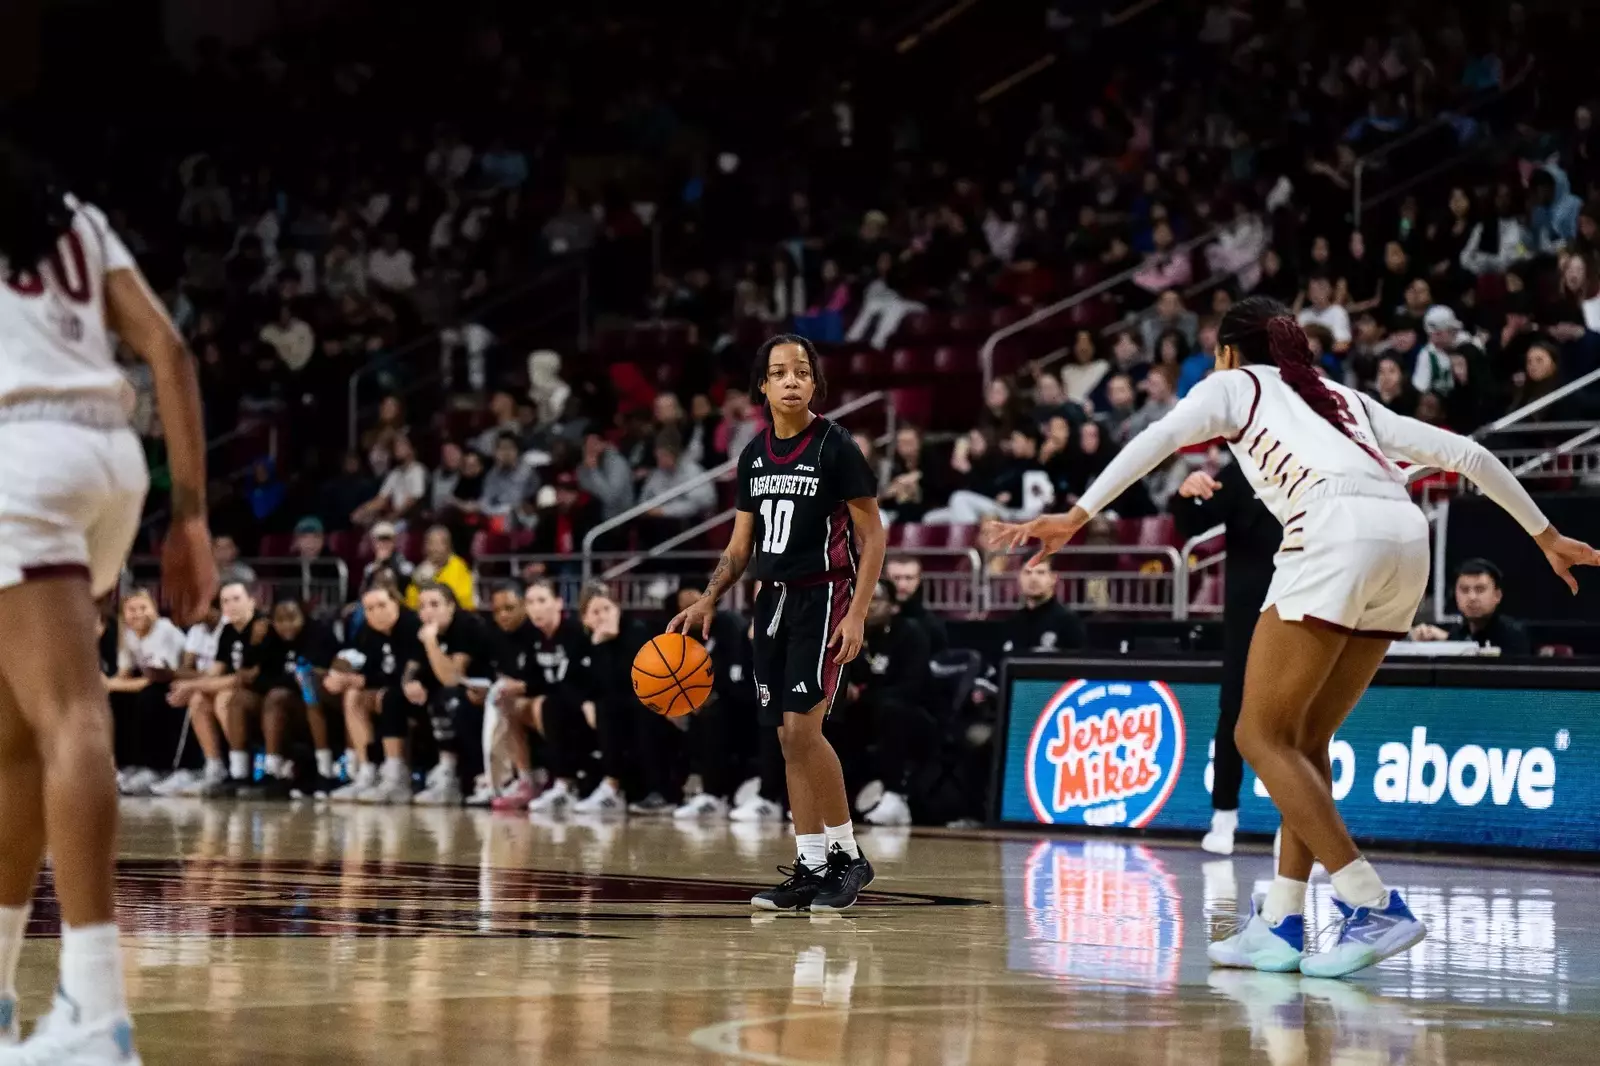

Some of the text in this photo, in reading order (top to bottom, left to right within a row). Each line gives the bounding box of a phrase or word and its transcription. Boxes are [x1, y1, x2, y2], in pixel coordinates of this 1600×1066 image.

[760, 500, 795, 554] 10
[1048, 705, 1161, 760] Jersey
[1373, 726, 1556, 809] above
